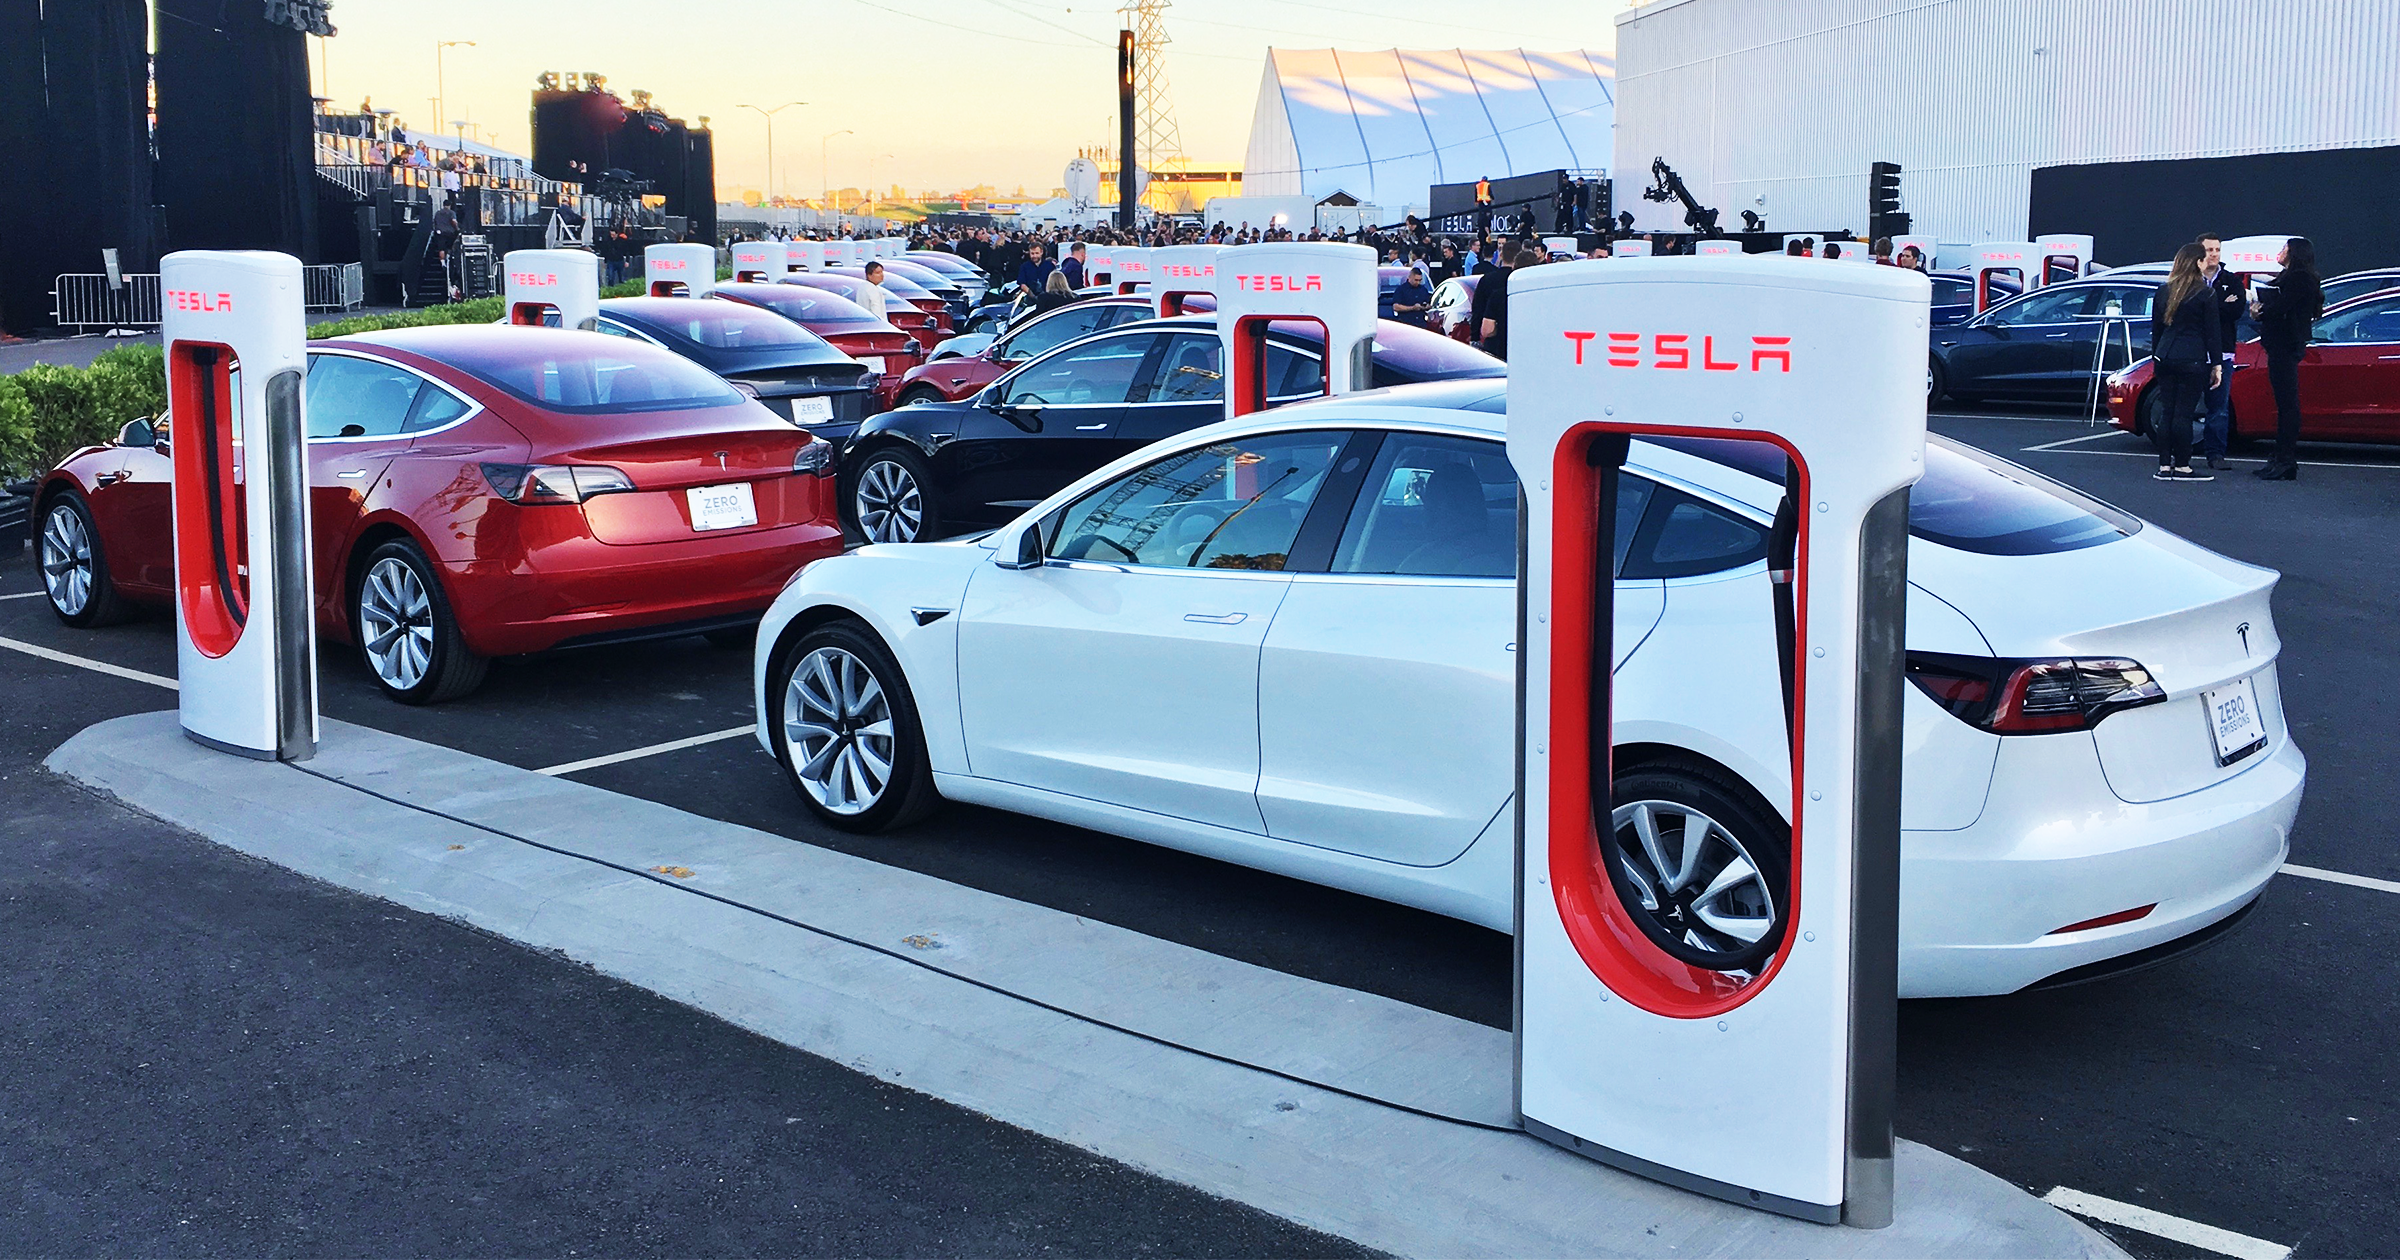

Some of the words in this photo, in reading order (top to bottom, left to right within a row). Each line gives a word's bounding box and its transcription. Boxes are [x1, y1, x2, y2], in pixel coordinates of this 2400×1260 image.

[1981, 252, 2022, 260] TESLA
[651, 260, 687, 270] TESLA
[1119, 262, 1149, 271] TESL
[1162, 265, 1214, 277] TESLA
[511, 273, 557, 286] TESLA
[1236, 275, 1322, 291] TESLA
[167, 291, 231, 312] TESLA
[1563, 331, 1792, 373] TESLA
[801, 403, 823, 412] ZERO
[704, 495, 738, 509] ZERO
[703, 506, 742, 516] EMISSIONS
[2218, 695, 2245, 724] ZERO
[2219, 712, 2250, 738] EMISSIONS
